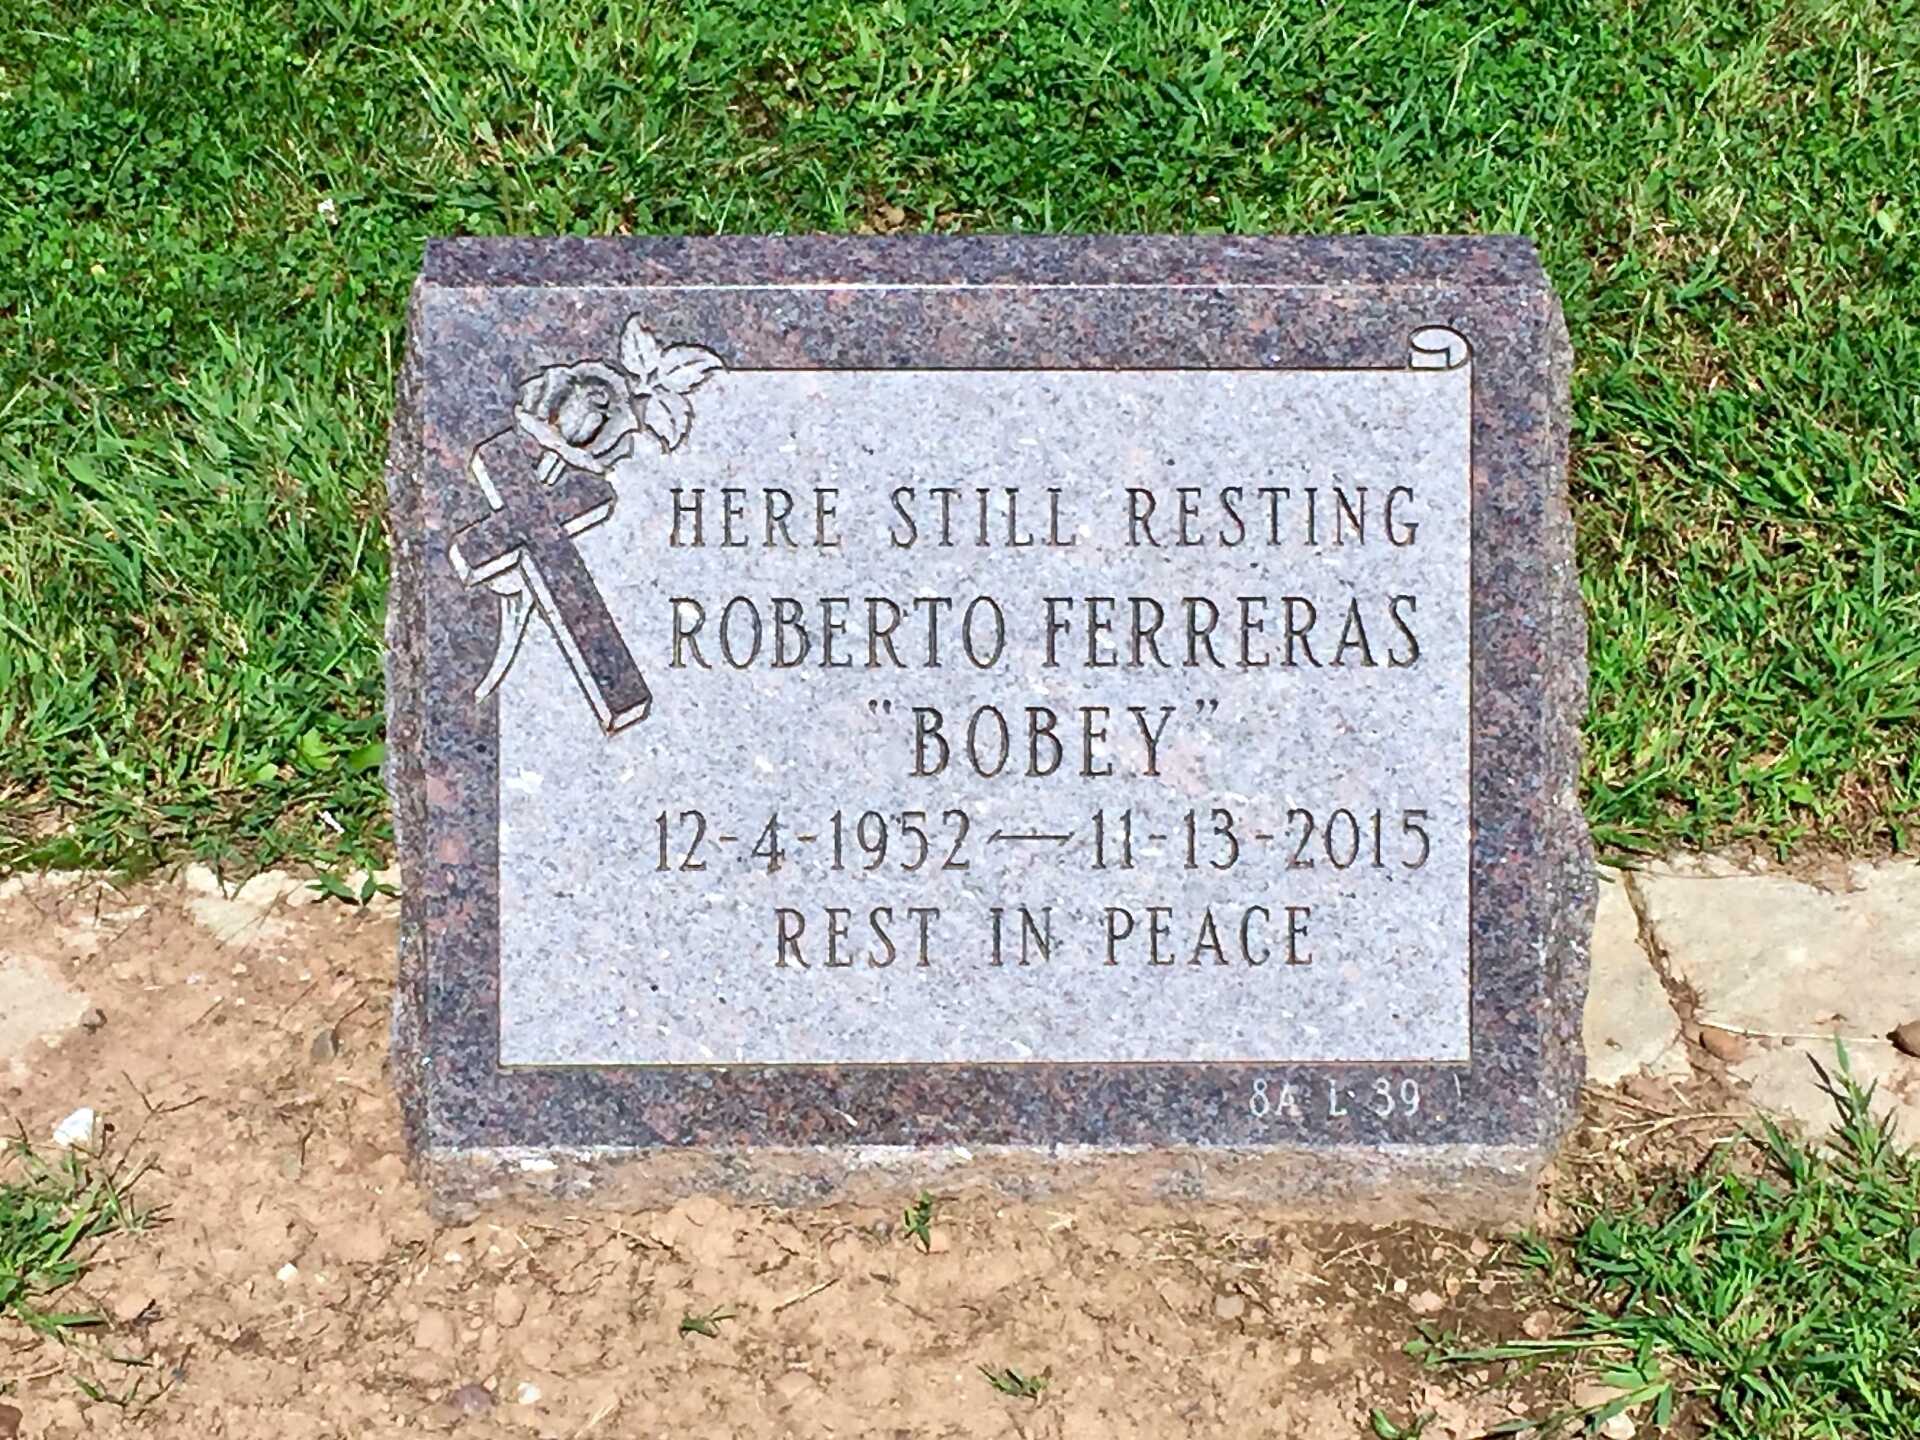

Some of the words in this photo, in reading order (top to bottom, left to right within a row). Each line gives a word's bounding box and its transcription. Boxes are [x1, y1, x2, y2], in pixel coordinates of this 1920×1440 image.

[669, 487, 842, 548] HERE
[888, 486, 1076, 549] STILL
[1124, 485, 1419, 547] RESTING
[668, 595, 1006, 670] ROBERTO
[1041, 594, 1421, 669] FERRERAS
[655, 808, 971, 874] 12-4-1952
[1091, 807, 1430, 870] 11-13-2015
[774, 906, 941, 969] REST
[989, 904, 1053, 967] IN
[1104, 904, 1313, 967] PEACE
